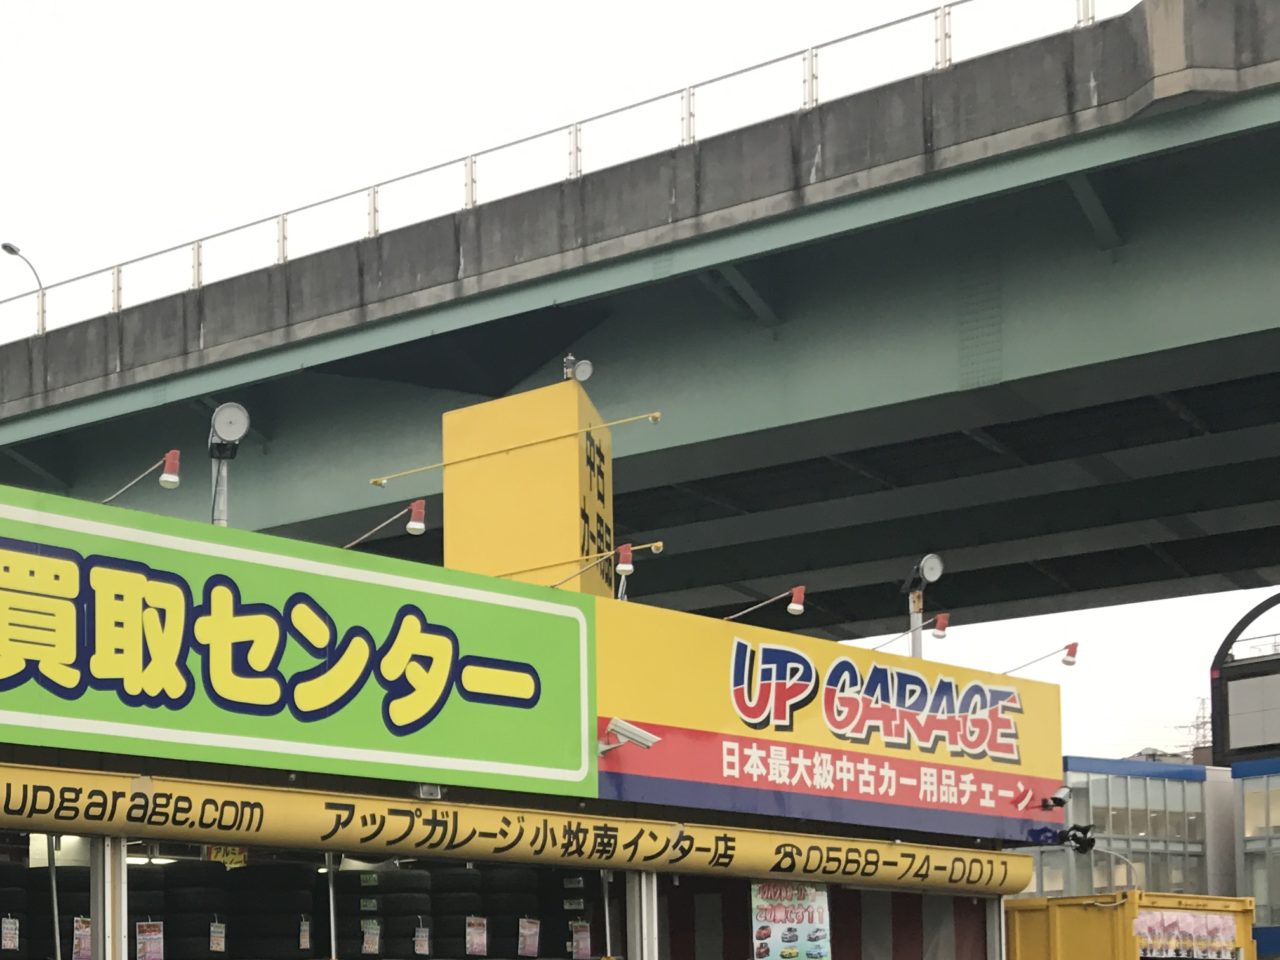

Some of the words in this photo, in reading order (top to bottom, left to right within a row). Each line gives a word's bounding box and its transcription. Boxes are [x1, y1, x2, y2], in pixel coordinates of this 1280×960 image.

[585, 423, 606, 509] 中古
[730, 637, 819, 731] UP
[823, 656, 1024, 764] GARAGE
[722, 741, 1034, 811] 日本最大級中古カー用品チェーン
